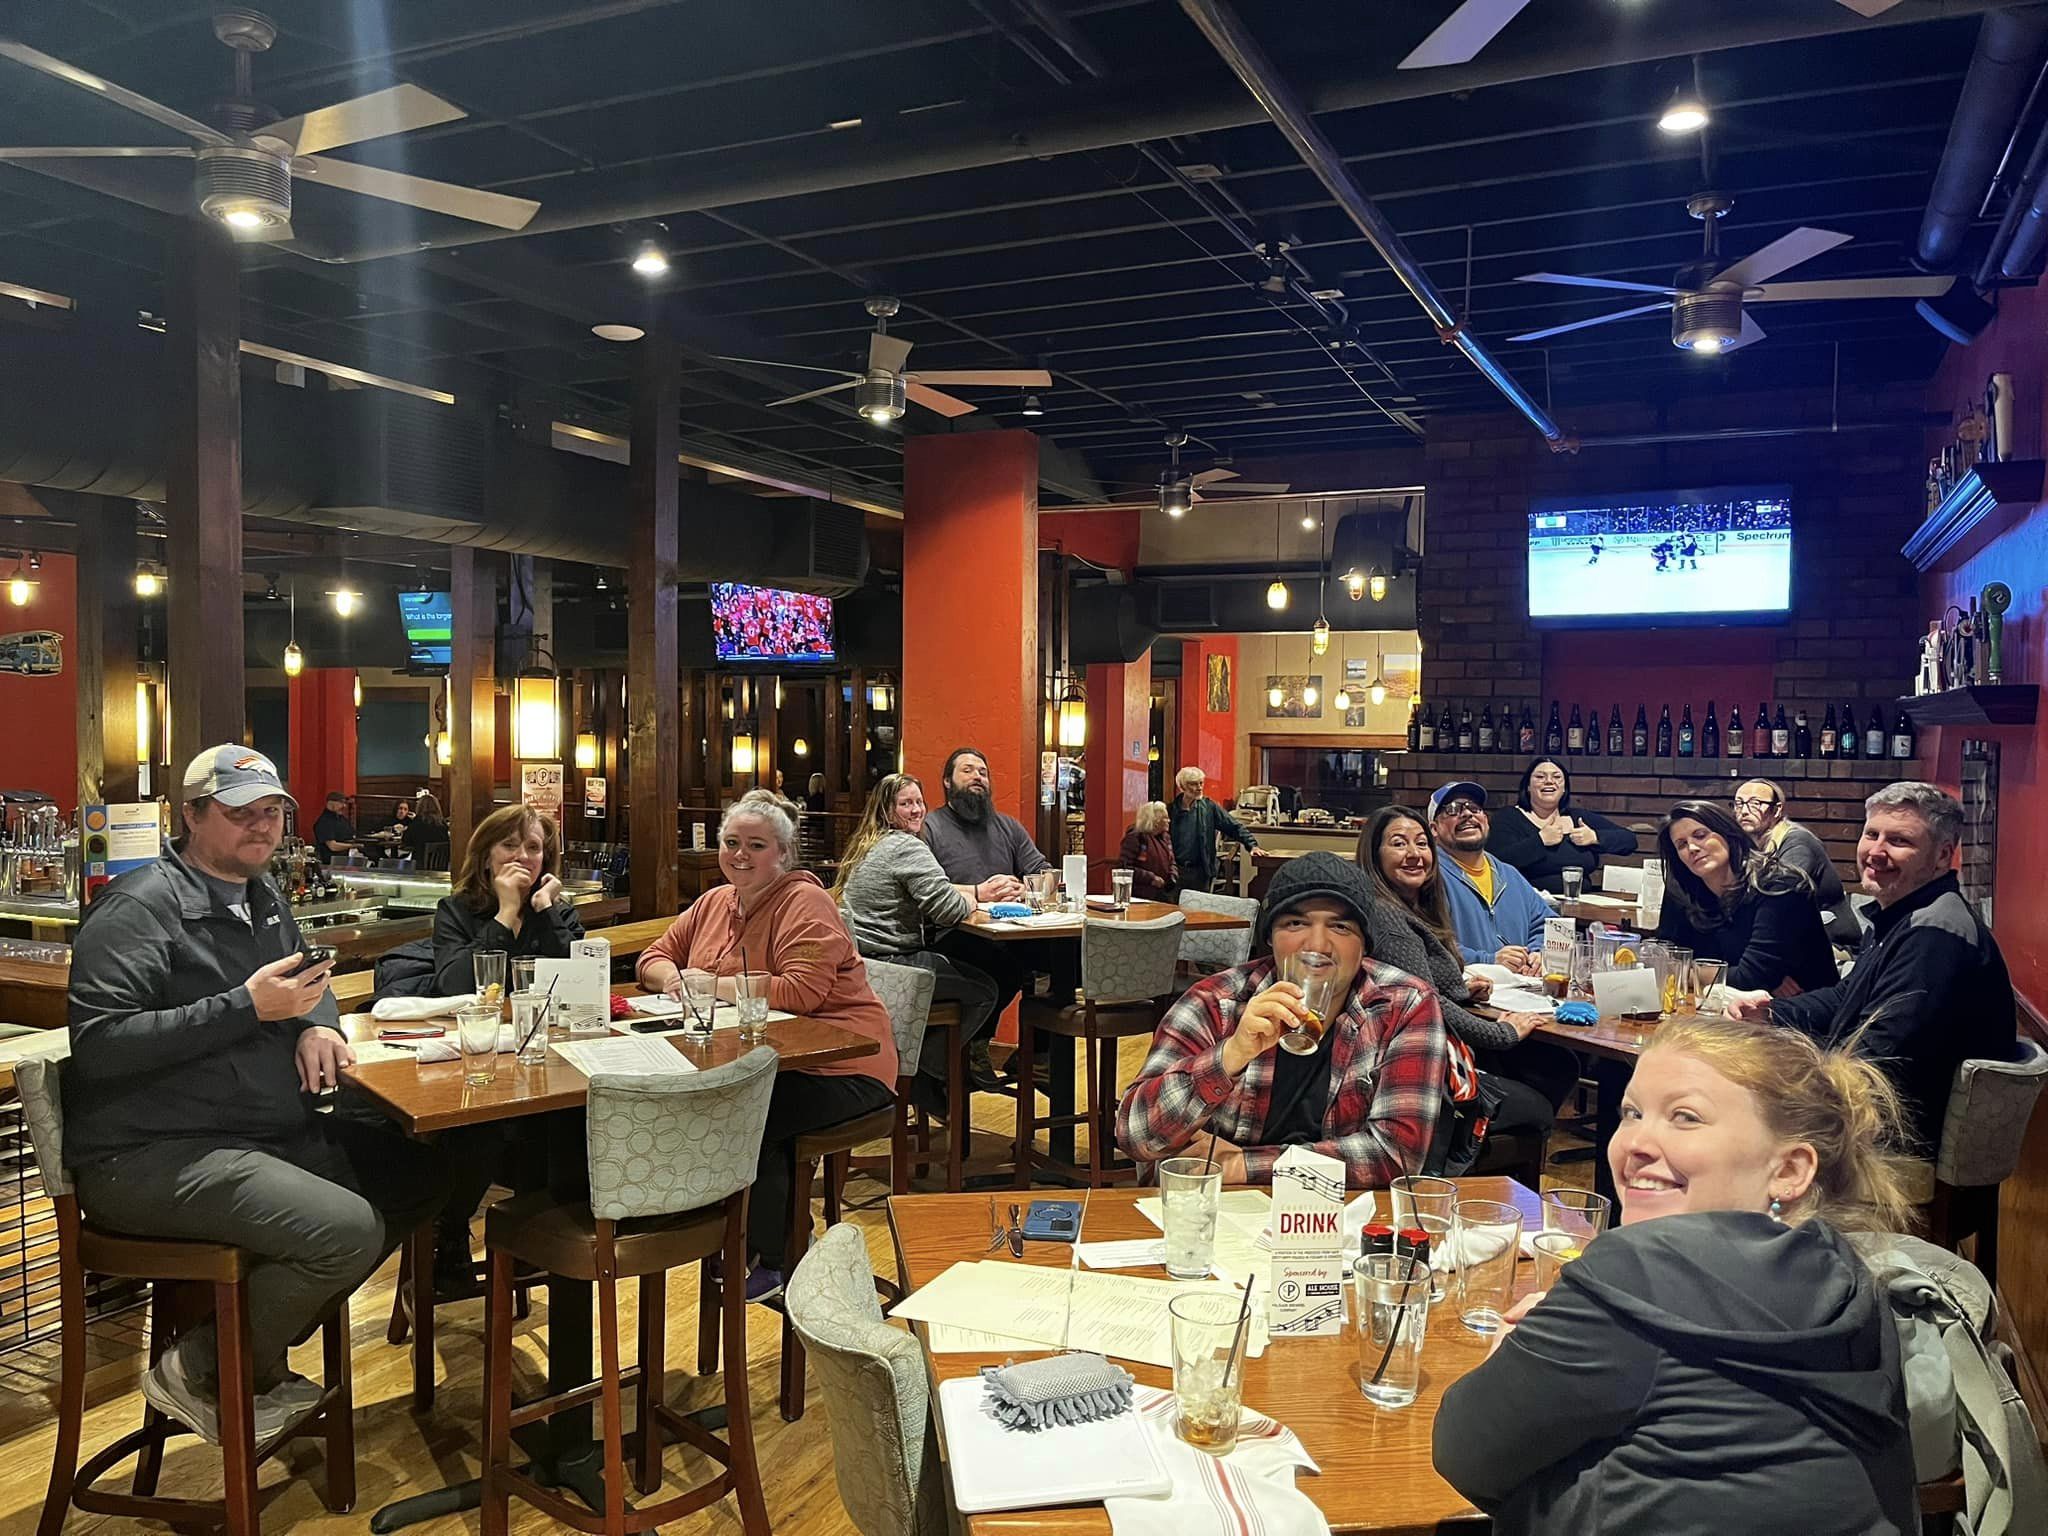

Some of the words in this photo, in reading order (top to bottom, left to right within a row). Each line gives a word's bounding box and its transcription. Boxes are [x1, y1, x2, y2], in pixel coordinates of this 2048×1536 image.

[1546, 940, 1570, 952] DRINK
[1281, 1213, 1338, 1233] DRINK
[1318, 1268, 1328, 1279] by
